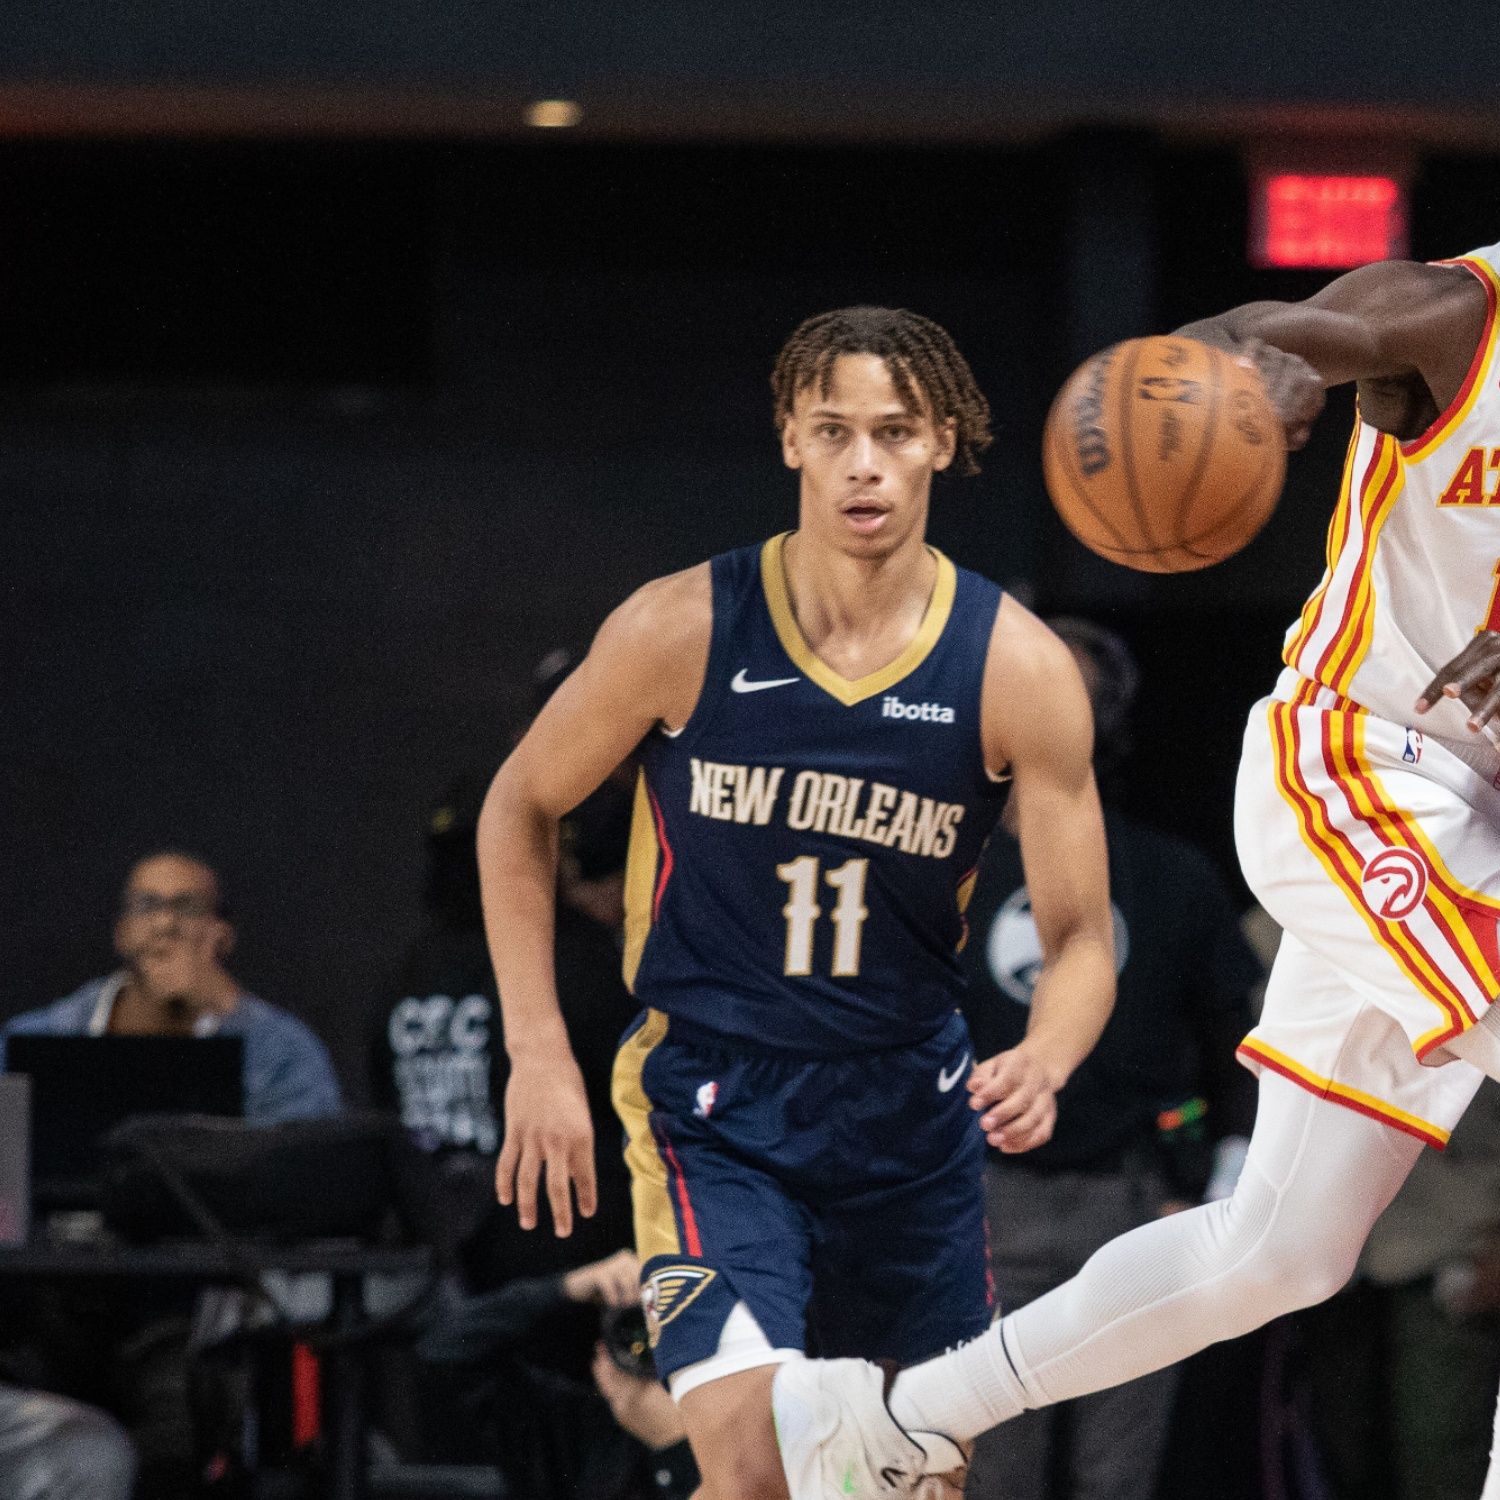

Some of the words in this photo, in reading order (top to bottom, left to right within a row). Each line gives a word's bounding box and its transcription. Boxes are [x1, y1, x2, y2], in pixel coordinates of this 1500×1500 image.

[881, 696, 956, 724] ibotta
[689, 757, 785, 826] NEW
[787, 769, 966, 859] ORLEANS
[775, 855, 870, 977] 11
